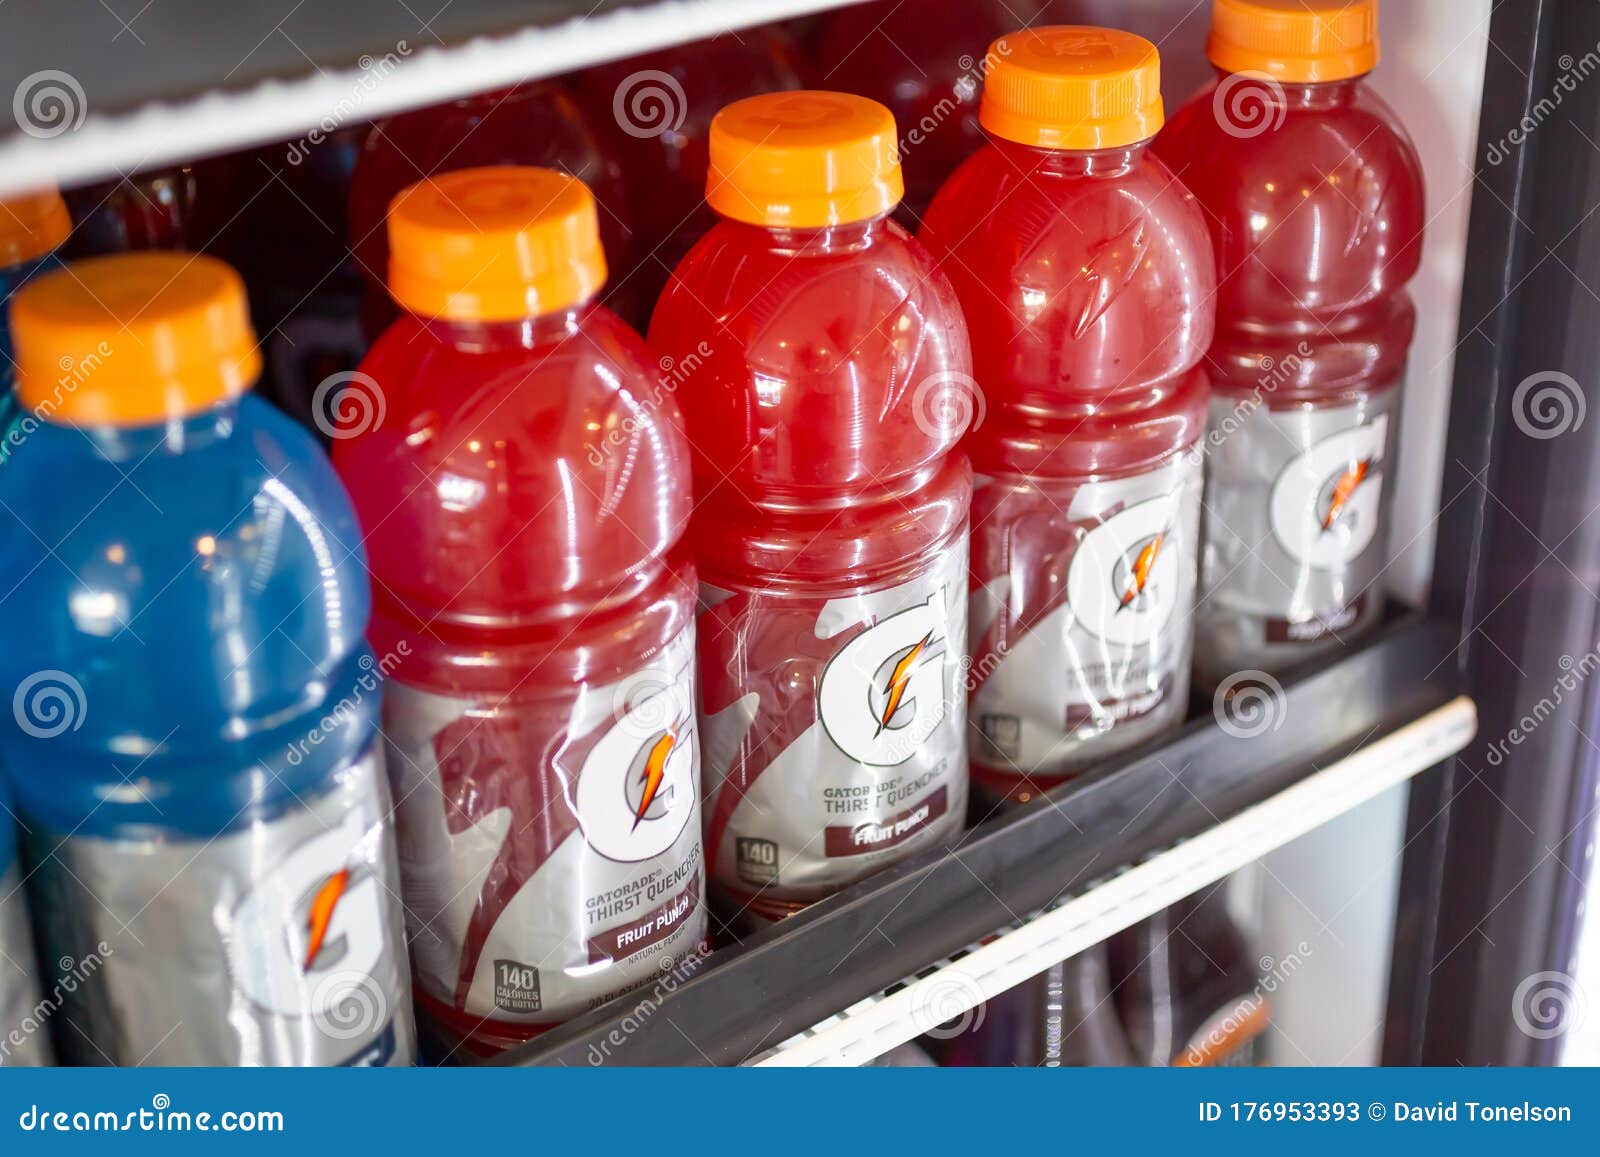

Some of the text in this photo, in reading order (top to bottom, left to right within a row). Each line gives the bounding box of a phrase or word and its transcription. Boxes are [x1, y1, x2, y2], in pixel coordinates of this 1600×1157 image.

[741, 841, 775, 865] 140
[586, 842, 700, 925] THIRST QUENCHER
[616, 895, 689, 949] FRUIT PUNCH
[628, 946, 662, 965] NATURAL
[500, 964, 534, 990] 140
